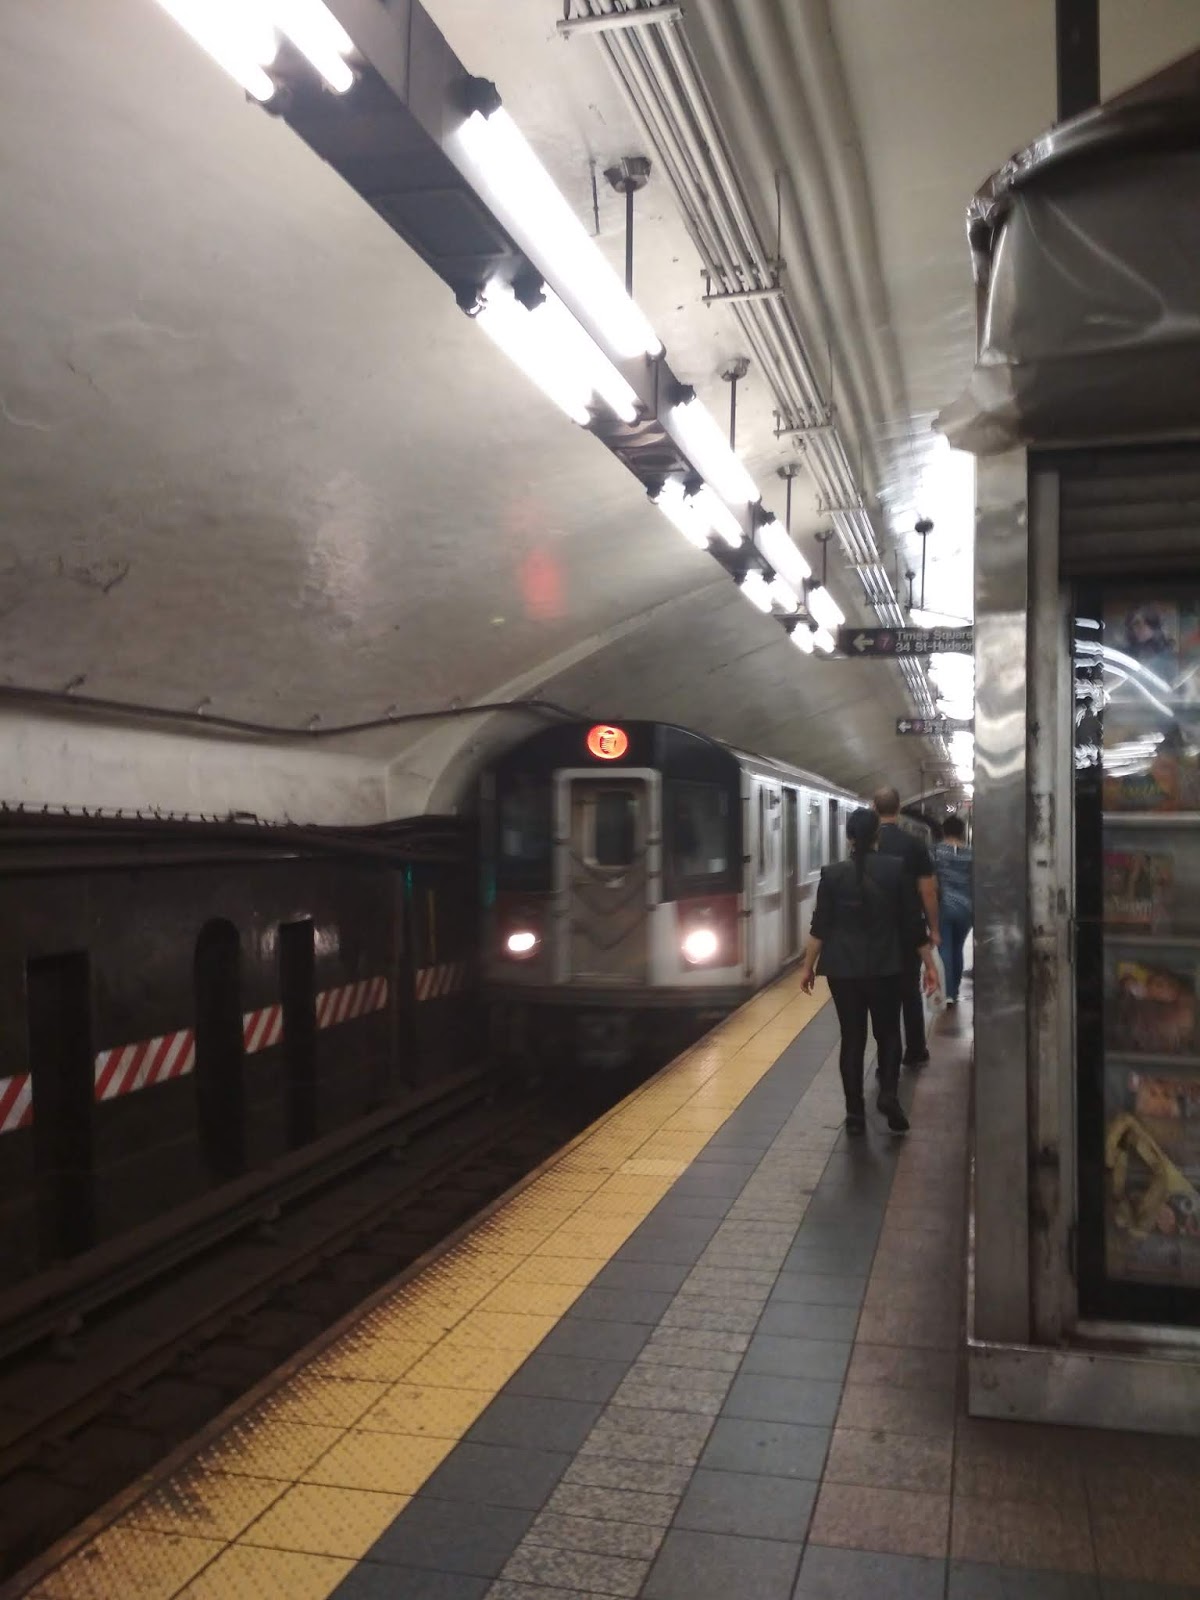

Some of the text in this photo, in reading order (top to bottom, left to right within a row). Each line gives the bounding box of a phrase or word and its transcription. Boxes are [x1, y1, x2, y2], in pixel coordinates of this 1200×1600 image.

[896, 630, 973, 642] Times Square
[880, 638, 888, 650] 7
[895, 642, 911, 653] 34
